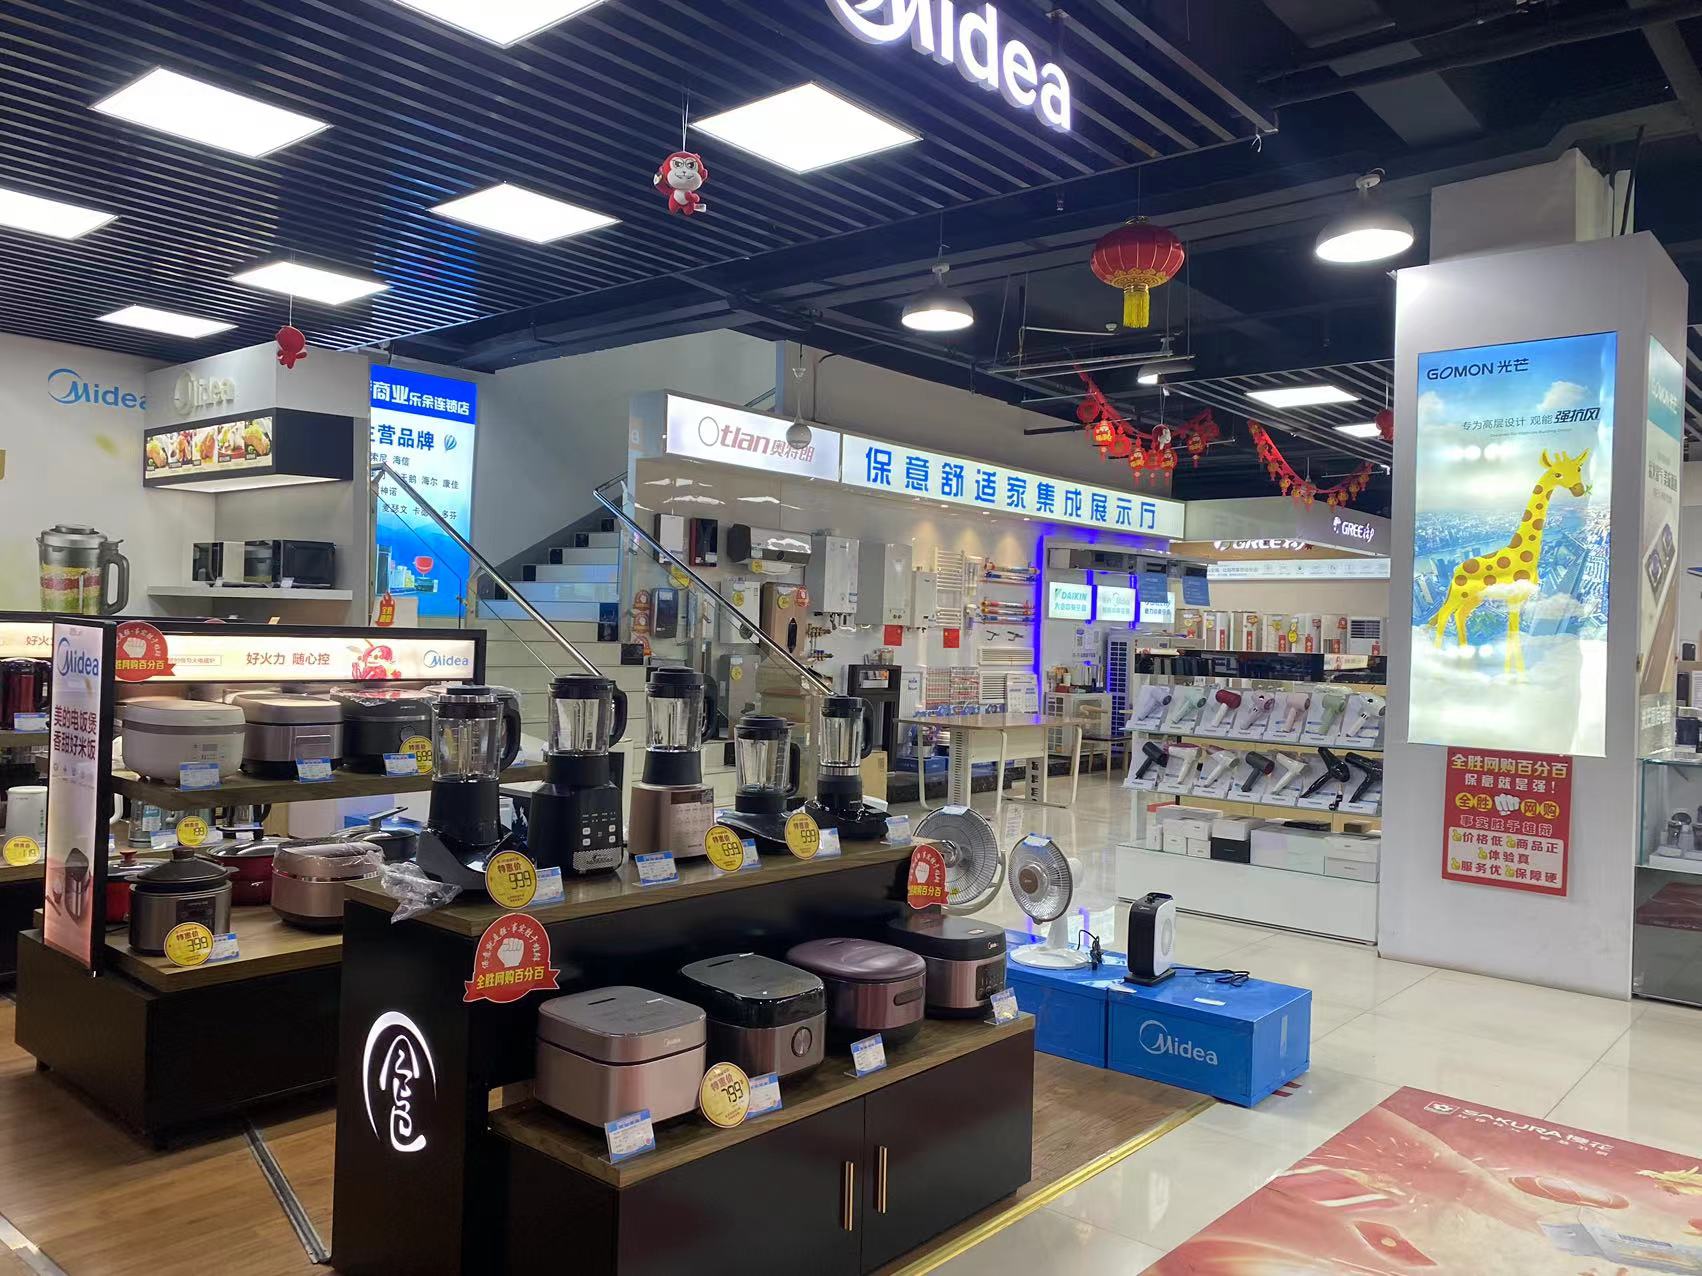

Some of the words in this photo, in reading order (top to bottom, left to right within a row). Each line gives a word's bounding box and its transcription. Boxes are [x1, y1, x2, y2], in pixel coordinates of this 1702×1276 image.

[826, 0, 1072, 132] Midea
[1426, 362, 1494, 380] GOMON
[1497, 358, 1529, 374] 光芒
[370, 379, 470, 416] 商业乐余连锁店
[1463, 416, 1527, 431] 专为高层设计
[1554, 407, 1601, 424] 强抗风
[370, 423, 435, 451] 营品牌
[769, 439, 815, 463] 奥特朗
[866, 446, 1156, 530] 保意舒适家集成展示厅
[1061, 591, 1087, 600] DAIKIN
[26, 635, 53, 646] 好火
[57, 637, 99, 676] Midea
[246, 652, 286, 666] 好火力
[292, 653, 331, 666] 随心控
[423, 650, 469, 668] Midea
[54, 705, 97, 736] 美的电饭煲
[53, 730, 96, 761] 香甜好米饭
[1452, 753, 1568, 778] 全胜网购百分百
[1459, 794, 1489, 812] 全胜
[1523, 801, 1556, 818] 网购
[801, 829, 817, 843] 599
[1463, 832, 1503, 847] 价格低
[1516, 838, 1559, 854] 商品正
[721, 842, 740, 857] 699
[1488, 849, 1529, 865] 体验真
[498, 862, 522, 874] 特惠价
[1461, 861, 1501, 876] 服务优
[1515, 868, 1558, 884] 保障硬
[508, 870, 532, 890] 999
[186, 935, 209, 952] 399
[476, 966, 545, 989] 全胜网购百分百
[1138, 1020, 1218, 1065] Midea
[721, 1081, 744, 1103] 799
[1461, 1109, 1562, 1139] SAKURA
